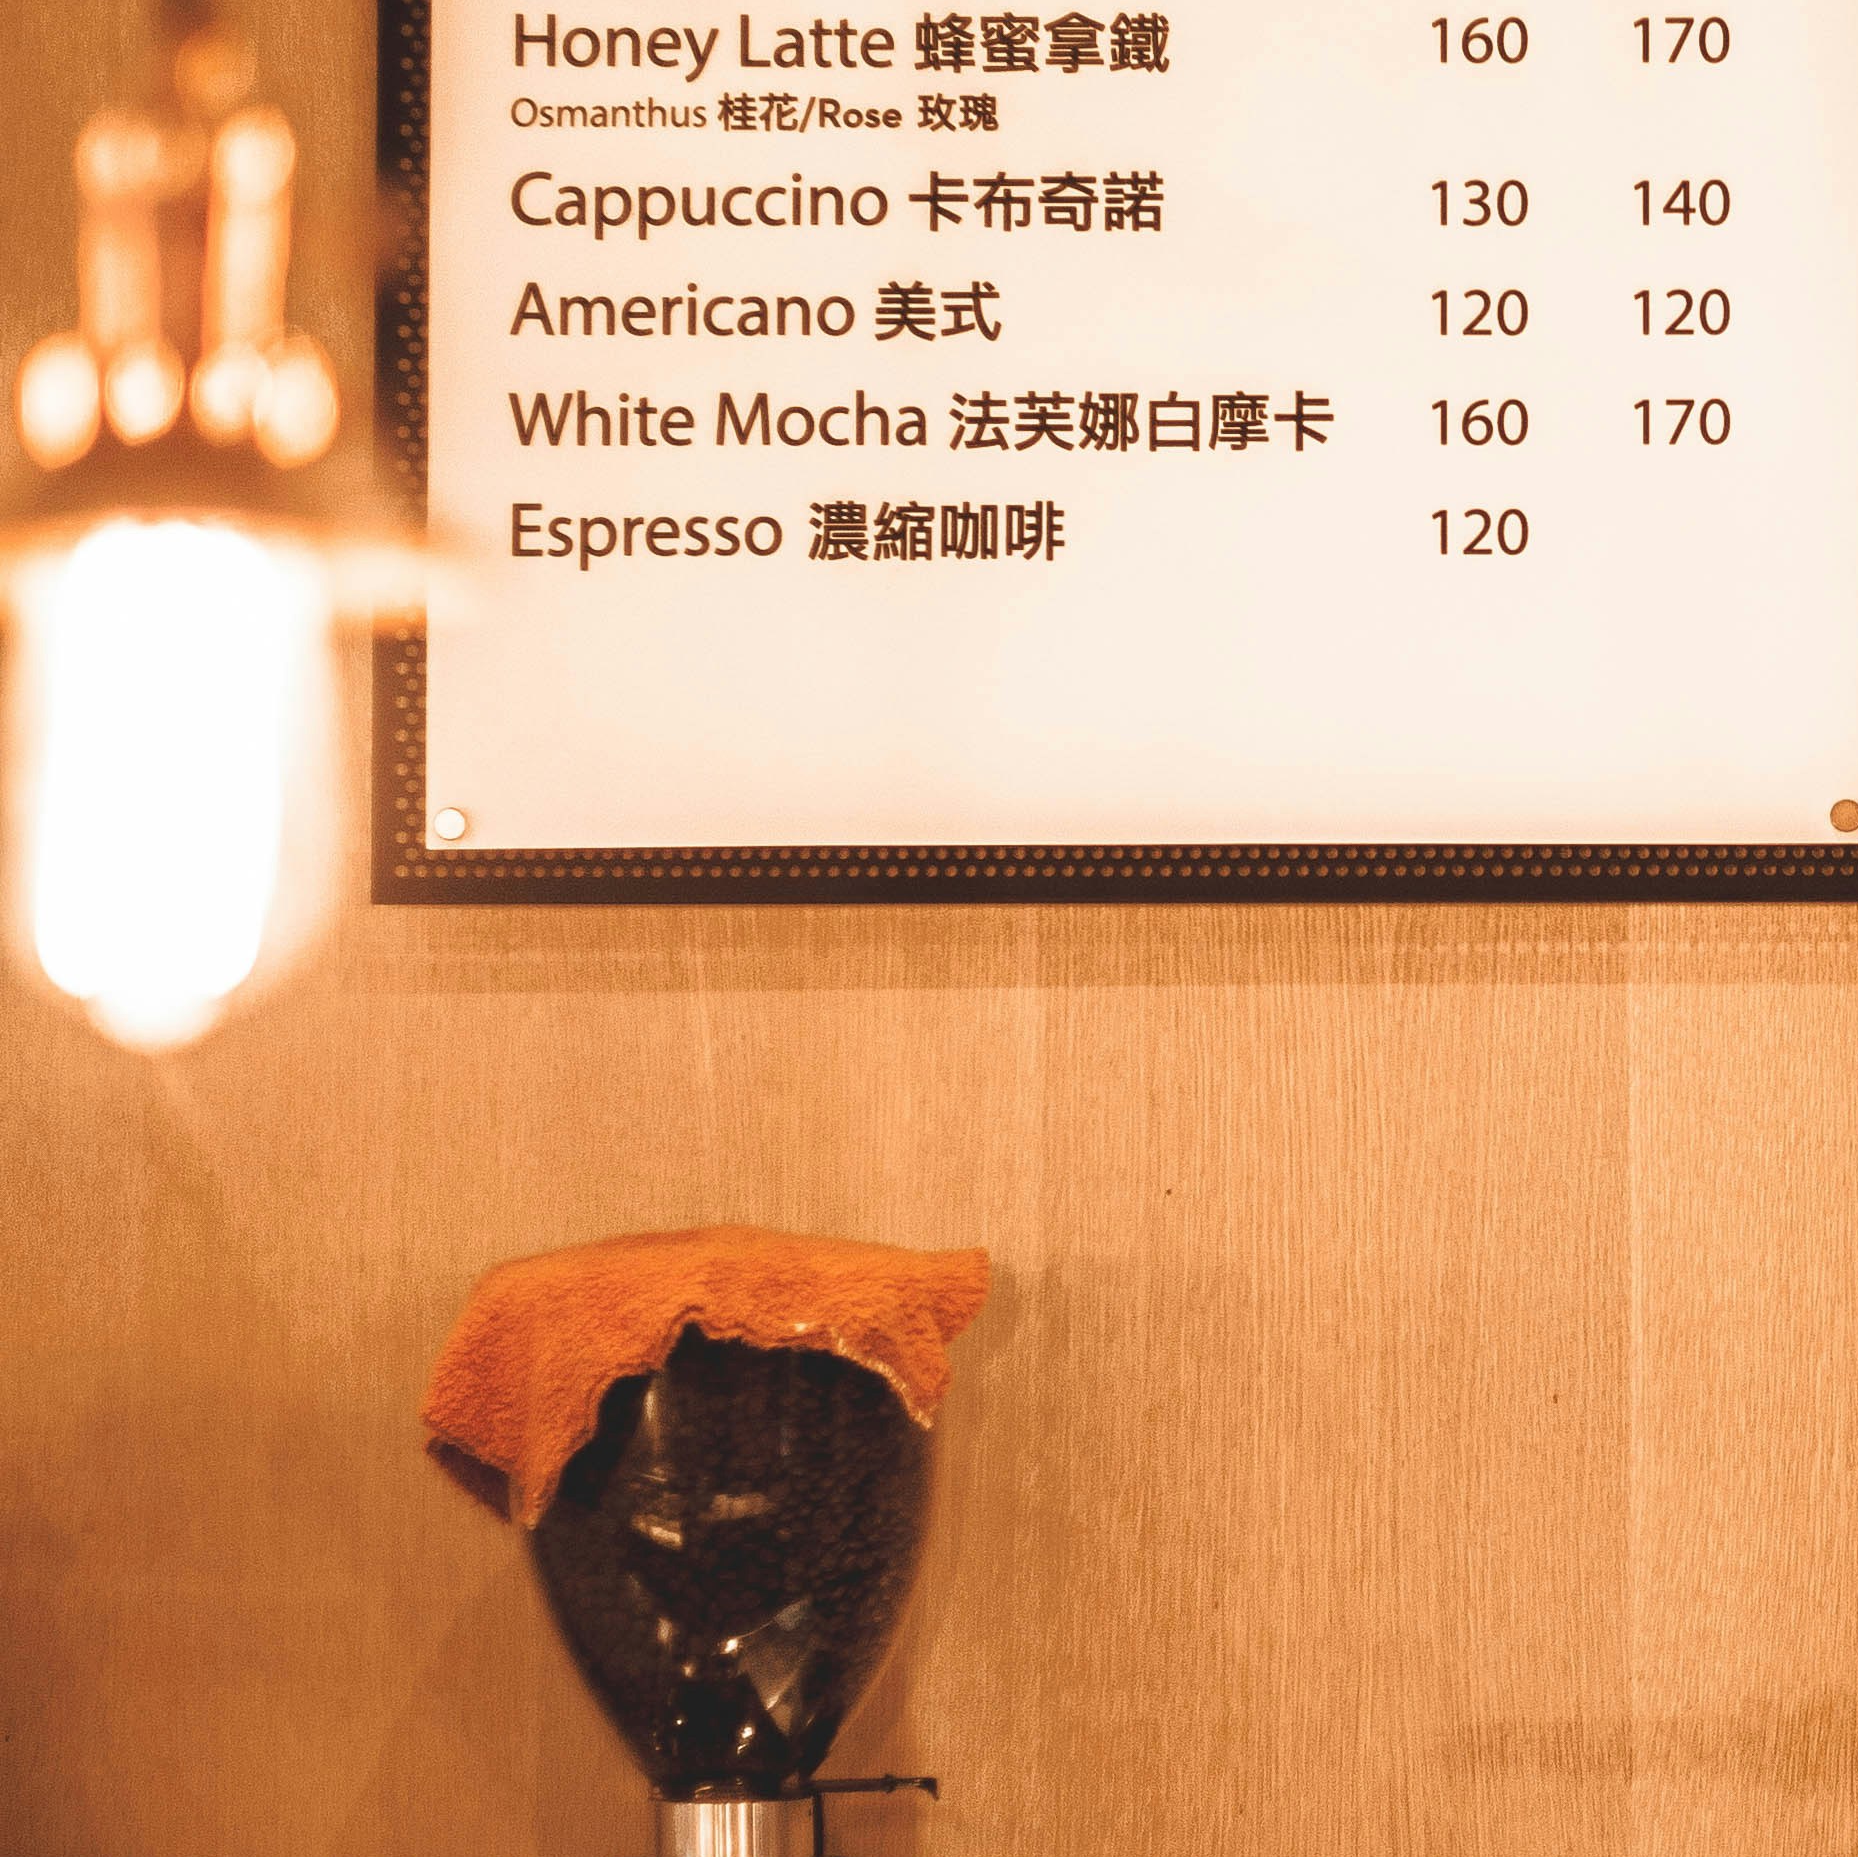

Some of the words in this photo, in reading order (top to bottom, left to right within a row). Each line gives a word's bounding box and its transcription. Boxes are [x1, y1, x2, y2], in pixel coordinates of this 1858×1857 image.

[514, 13, 720, 83] Honey
[739, 13, 895, 69] Latte
[913, 11, 1170, 74] 蜂蜜拿鐵
[1431, 16, 1529, 65] 160
[1633, 16, 1730, 64] 170
[510, 96, 708, 128] Osmanthus
[917, 92, 1000, 133] 玫瑰
[510, 171, 889, 241] Cappuccino
[908, 170, 1165, 233] 卡布奇諾
[1431, 179, 1529, 227] 130
[1633, 179, 1731, 227] 140
[509, 281, 856, 337] Americano
[874, 280, 1002, 342] 美式
[1431, 288, 1529, 337] 120
[1633, 288, 1731, 336] 120
[508, 389, 695, 447] White
[715, 389, 927, 447] Mocha
[948, 390, 1335, 453] 法芙娜白摩卡
[1431, 398, 1529, 447] 160
[1633, 398, 1731, 446] 170
[511, 502, 783, 572] Espresso
[807, 500, 1066, 562] 濃縮咖啡
[1431, 508, 1529, 556] 120
